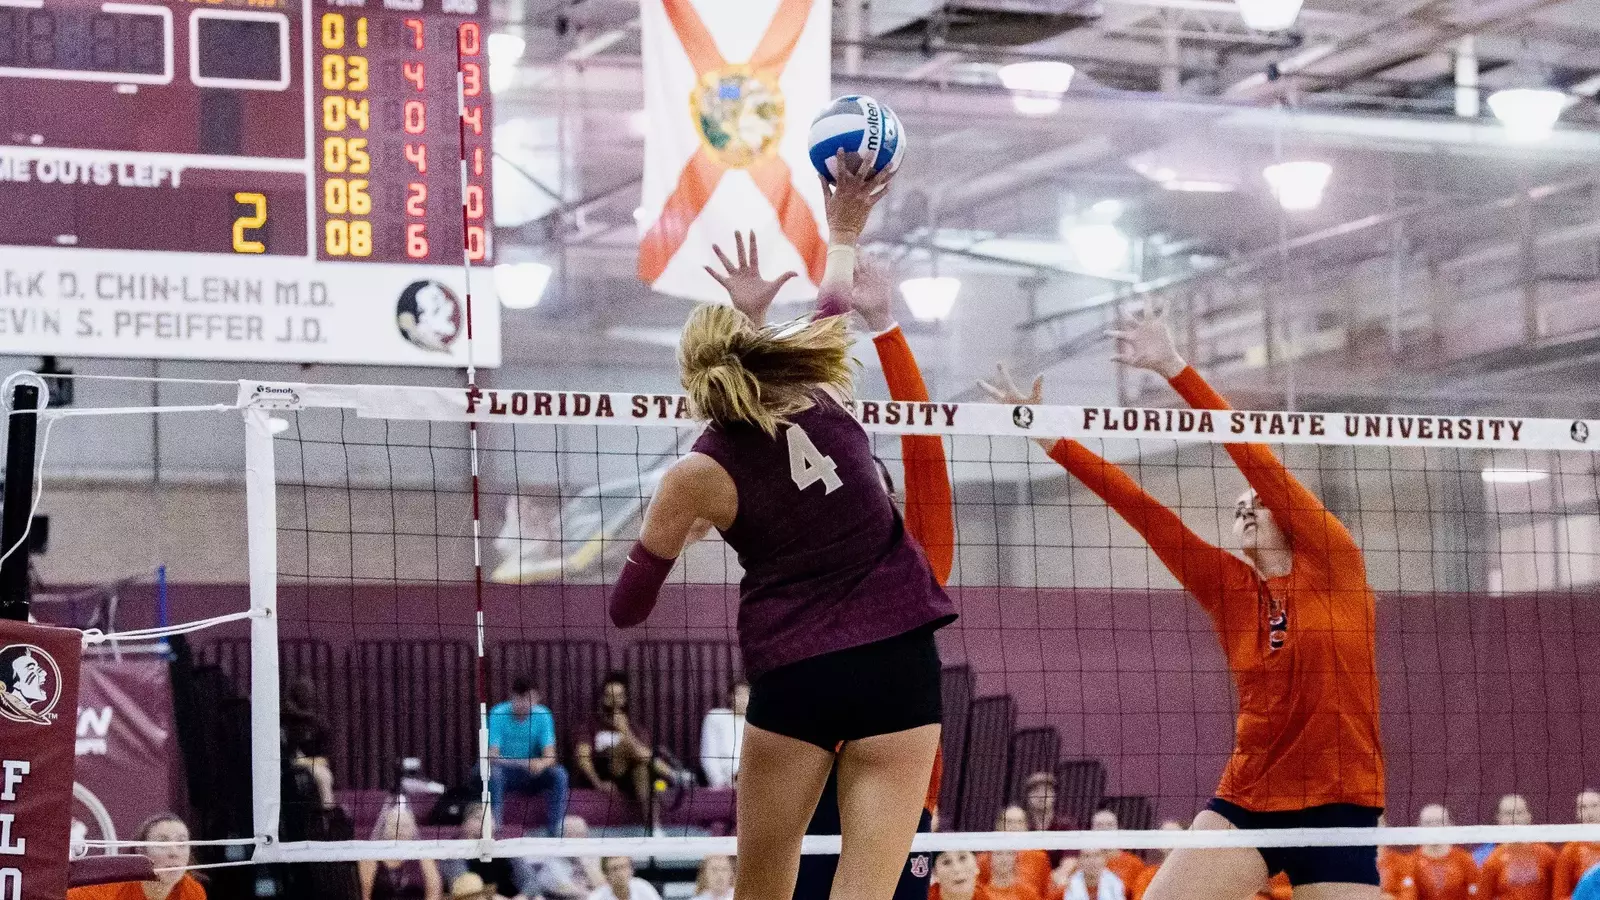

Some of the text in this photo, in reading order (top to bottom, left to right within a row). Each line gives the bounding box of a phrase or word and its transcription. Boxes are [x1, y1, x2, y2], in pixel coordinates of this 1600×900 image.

[322, 13, 480, 56] 01 7 0
[322, 54, 482, 96] 03 4 3
[322, 95, 483, 136] 04 0 4
[866, 102, 880, 152] molten
[36, 158, 112, 185] OUTS
[118, 161, 181, 188] LEFT
[323, 136, 483, 176] 05 4 1
[324, 178, 485, 219] 06 2 0
[232, 192, 267, 253] 2
[325, 219, 486, 261] 08 6 0
[0, 269, 44, 298] RK
[95, 271, 263, 305] CHIN-LENN
[114, 310, 263, 342] PFEIFFER
[264, 386, 294, 394] Senoh
[465, 391, 614, 418] FLORIDA
[1083, 407, 1524, 442] FLORIDA STATE UNIVERSITY
[785, 423, 844, 497] 4
